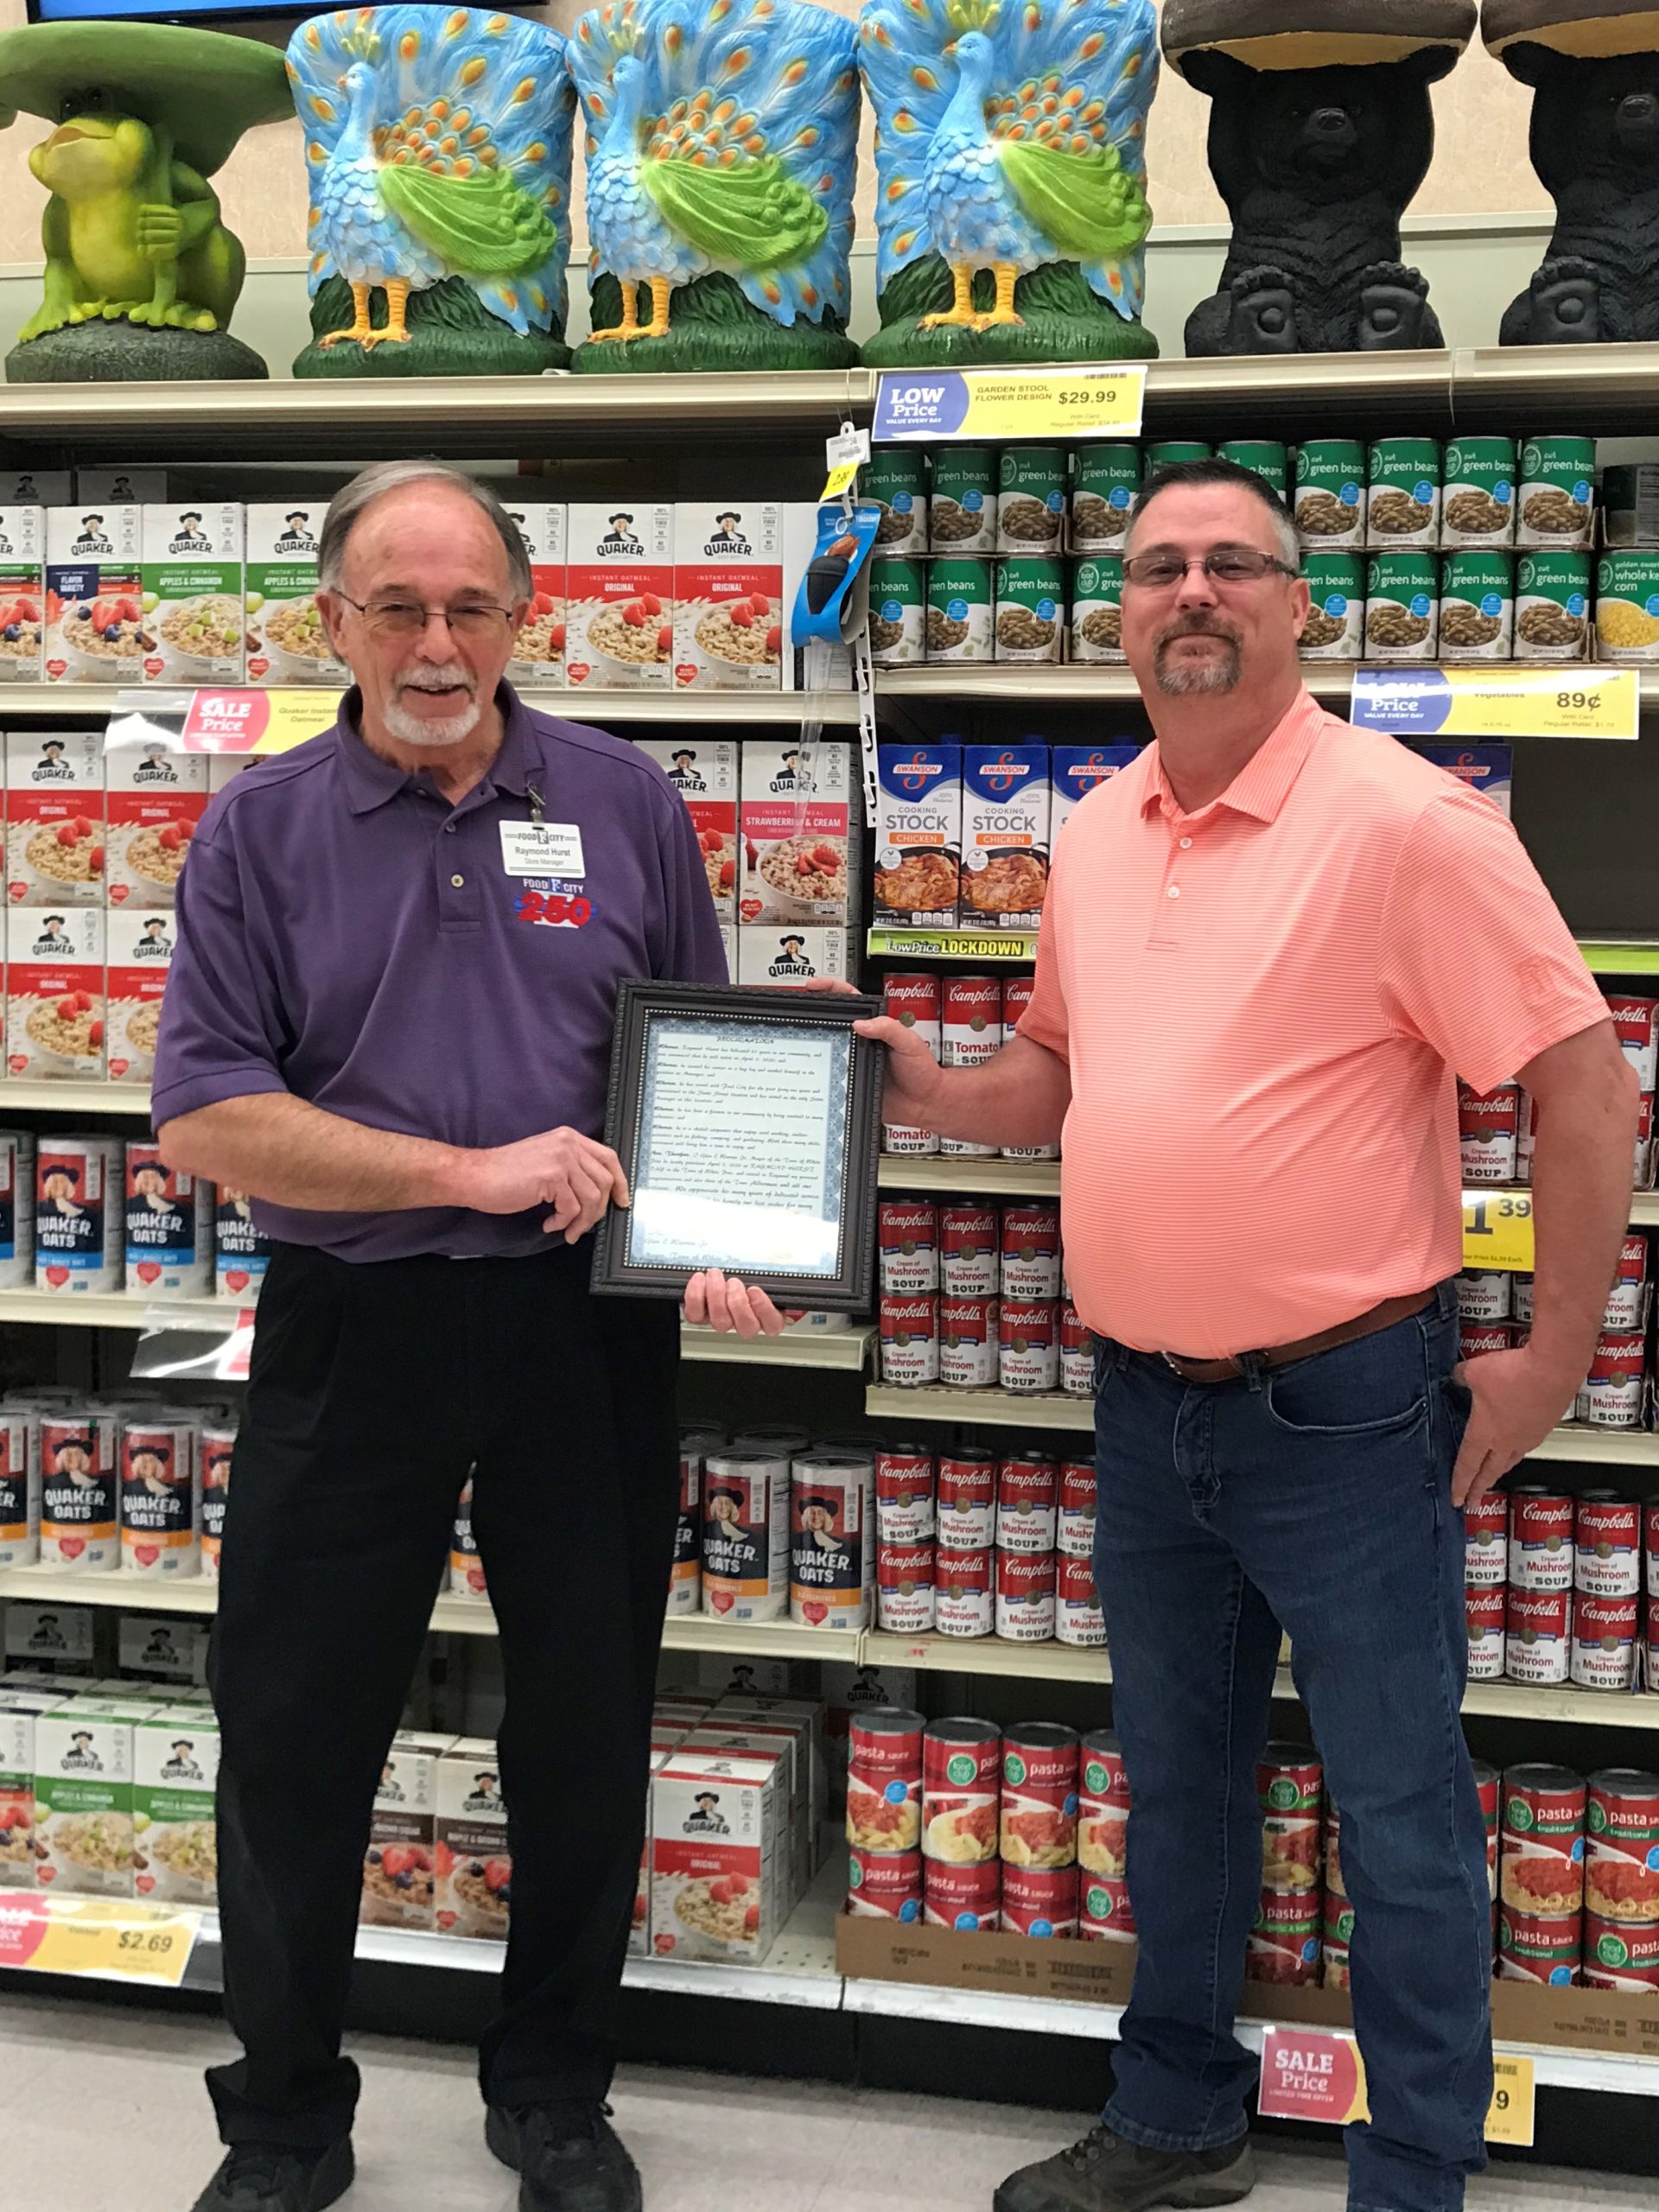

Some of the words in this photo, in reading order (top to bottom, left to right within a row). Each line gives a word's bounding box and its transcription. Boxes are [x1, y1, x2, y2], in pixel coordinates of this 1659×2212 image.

[890, 387, 945, 404] LOW
[1015, 392, 1052, 401] DESIGN
[1058, 390, 1116, 406] $29.99
[893, 404, 937, 417] Price
[1082, 468, 1106, 481] green
[1108, 467, 1136, 479] beans
[1310, 464, 1338, 477] green
[1383, 461, 1412, 474] green
[1414, 461, 1439, 473] beans
[1462, 461, 1491, 474] green
[1542, 461, 1572, 474] green
[891, 472, 918, 484] beans
[937, 471, 961, 484] green
[962, 470, 989, 482] beans
[71, 540, 114, 555] QUAKER
[168, 540, 213, 555] QUAKER
[596, 543, 645, 557] QUAKER
[703, 543, 753, 557] QUAKER
[1325, 573, 1354, 586] beans
[1382, 575, 1409, 587] green
[1411, 574, 1436, 586] beans
[1452, 575, 1479, 587] green
[1482, 574, 1509, 586] beans
[1536, 574, 1566, 586] green
[1615, 569, 1646, 582] whole
[605, 582, 635, 593] ORIGINAL
[712, 582, 743, 593] ORIGINAL
[881, 582, 909, 593] beans
[947, 580, 976, 591] beans
[1008, 580, 1035, 593] green
[1037, 579, 1061, 591] beans
[1614, 582, 1637, 592] corn
[200, 697, 252, 718] SALE
[1370, 699, 1419, 712] Price
[1556, 692, 1602, 712] 89¢
[279, 707, 309, 715] Quaker
[200, 718, 243, 731] Price
[32, 769, 75, 782] QUAKER
[896, 765, 938, 773] SWANSON
[982, 766, 1025, 774] SWANSON
[133, 770, 179, 784] QUAKER
[769, 779, 817, 793] QUAKER
[806, 818, 812, 827] &
[813, 817, 842, 828] CREAM
[886, 815, 949, 830] STOCK
[972, 816, 1036, 831] STOCK
[518, 832, 537, 841] FOOD
[896, 835, 938, 843] CHICKEN
[982, 836, 1025, 844] CHICKEN
[515, 846, 550, 858] Raymond
[551, 849, 571, 857] Hurst
[523, 878, 549, 890] FOOD
[563, 884, 584, 893] CITY
[518, 892, 591, 927] 250
[886, 938, 940, 955] LowPrice
[940, 939, 1023, 957] LOCKDOWN
[768, 964, 816, 977] QUAKER
[884, 980, 935, 1001] Campbell's
[949, 983, 1001, 1006] Campbell's
[956, 1042, 999, 1054] Tomato
[887, 1127, 932, 1141] Tomato
[893, 1142, 925, 1151] SOUP
[1009, 1147, 1042, 1156] SOUP
[1465, 1168, 1503, 1179] SOUP
[881, 1209, 934, 1230] Campbell's
[1465, 1199, 1493, 1236] 1
[1497, 1198, 1532, 1218] 39
[943, 1214, 995, 1236] Campbell's
[1004, 1213, 1056, 1236] Campbell's
[42, 1233, 76, 1249] OATS
[133, 1229, 168, 1244] OATS
[223, 1237, 256, 1252] OATS
[887, 1266, 931, 1277] Mushroom
[947, 1270, 990, 1281] Mushroom
[1006, 1271, 1049, 1283] Mushroom
[892, 1279, 925, 1289] SOUP
[952, 1284, 985, 1294] SOUP
[1009, 1285, 1044, 1295] SOUP
[880, 1299, 932, 1320] Campbell's
[887, 1370, 919, 1379] SOUP
[1004, 1376, 1036, 1387] SOUP
[1599, 1412, 1634, 1422] SOUP
[880, 1460, 931, 1482] Campbell's
[940, 1464, 991, 1488] Campbell's
[1001, 1465, 1053, 1488] Campbell's
[45, 1489, 106, 1506] QUAKER
[123, 1495, 181, 1514] QUAKER
[54, 1505, 92, 1519] OATS
[130, 1512, 166, 1528] OATS
[1578, 1509, 1635, 1531] Campbell's
[889, 1529, 920, 1539] SOUP
[942, 1522, 984, 1535] Mushroom
[1001, 1522, 1047, 1536] Mushroom
[945, 1535, 978, 1546] SOUP
[1006, 1537, 1039, 1548] SOUP
[703, 1538, 756, 1562] QUAKER
[708, 1555, 741, 1573] OATS
[791, 1548, 851, 1571] QUAKER
[799, 1567, 835, 1583] OATS
[1580, 1565, 1630, 1580] Mushroom
[1535, 1576, 1568, 1586] SOUP
[1586, 1582, 1622, 1593] SOUP
[883, 1604, 930, 1617] Mushroom
[1581, 1601, 1637, 1624] Campbell's
[890, 1618, 923, 1629] SOUP
[1015, 1628, 1049, 1639] SOUP
[1589, 1675, 1625, 1686] SOUP
[855, 1744, 886, 1761] pasta
[952, 1762, 972, 1771] food
[1029, 1763, 1065, 1777] pasta
[952, 1770, 969, 1779] club
[1537, 1806, 1573, 1821] pasta
[1610, 1811, 1647, 1827] pasta
[1610, 1827, 1650, 1839] traditional
[865, 1869, 900, 1882] pasta
[118, 1930, 173, 1954] $2.69
[1514, 1928, 1550, 1946] pasta
[1601, 1941, 1622, 1952] food
[1602, 1951, 1621, 1963] club
[1275, 2049, 1333, 2075] SALE
[1281, 2070, 1329, 2093] Price
[1496, 2089, 1510, 2110] 9
